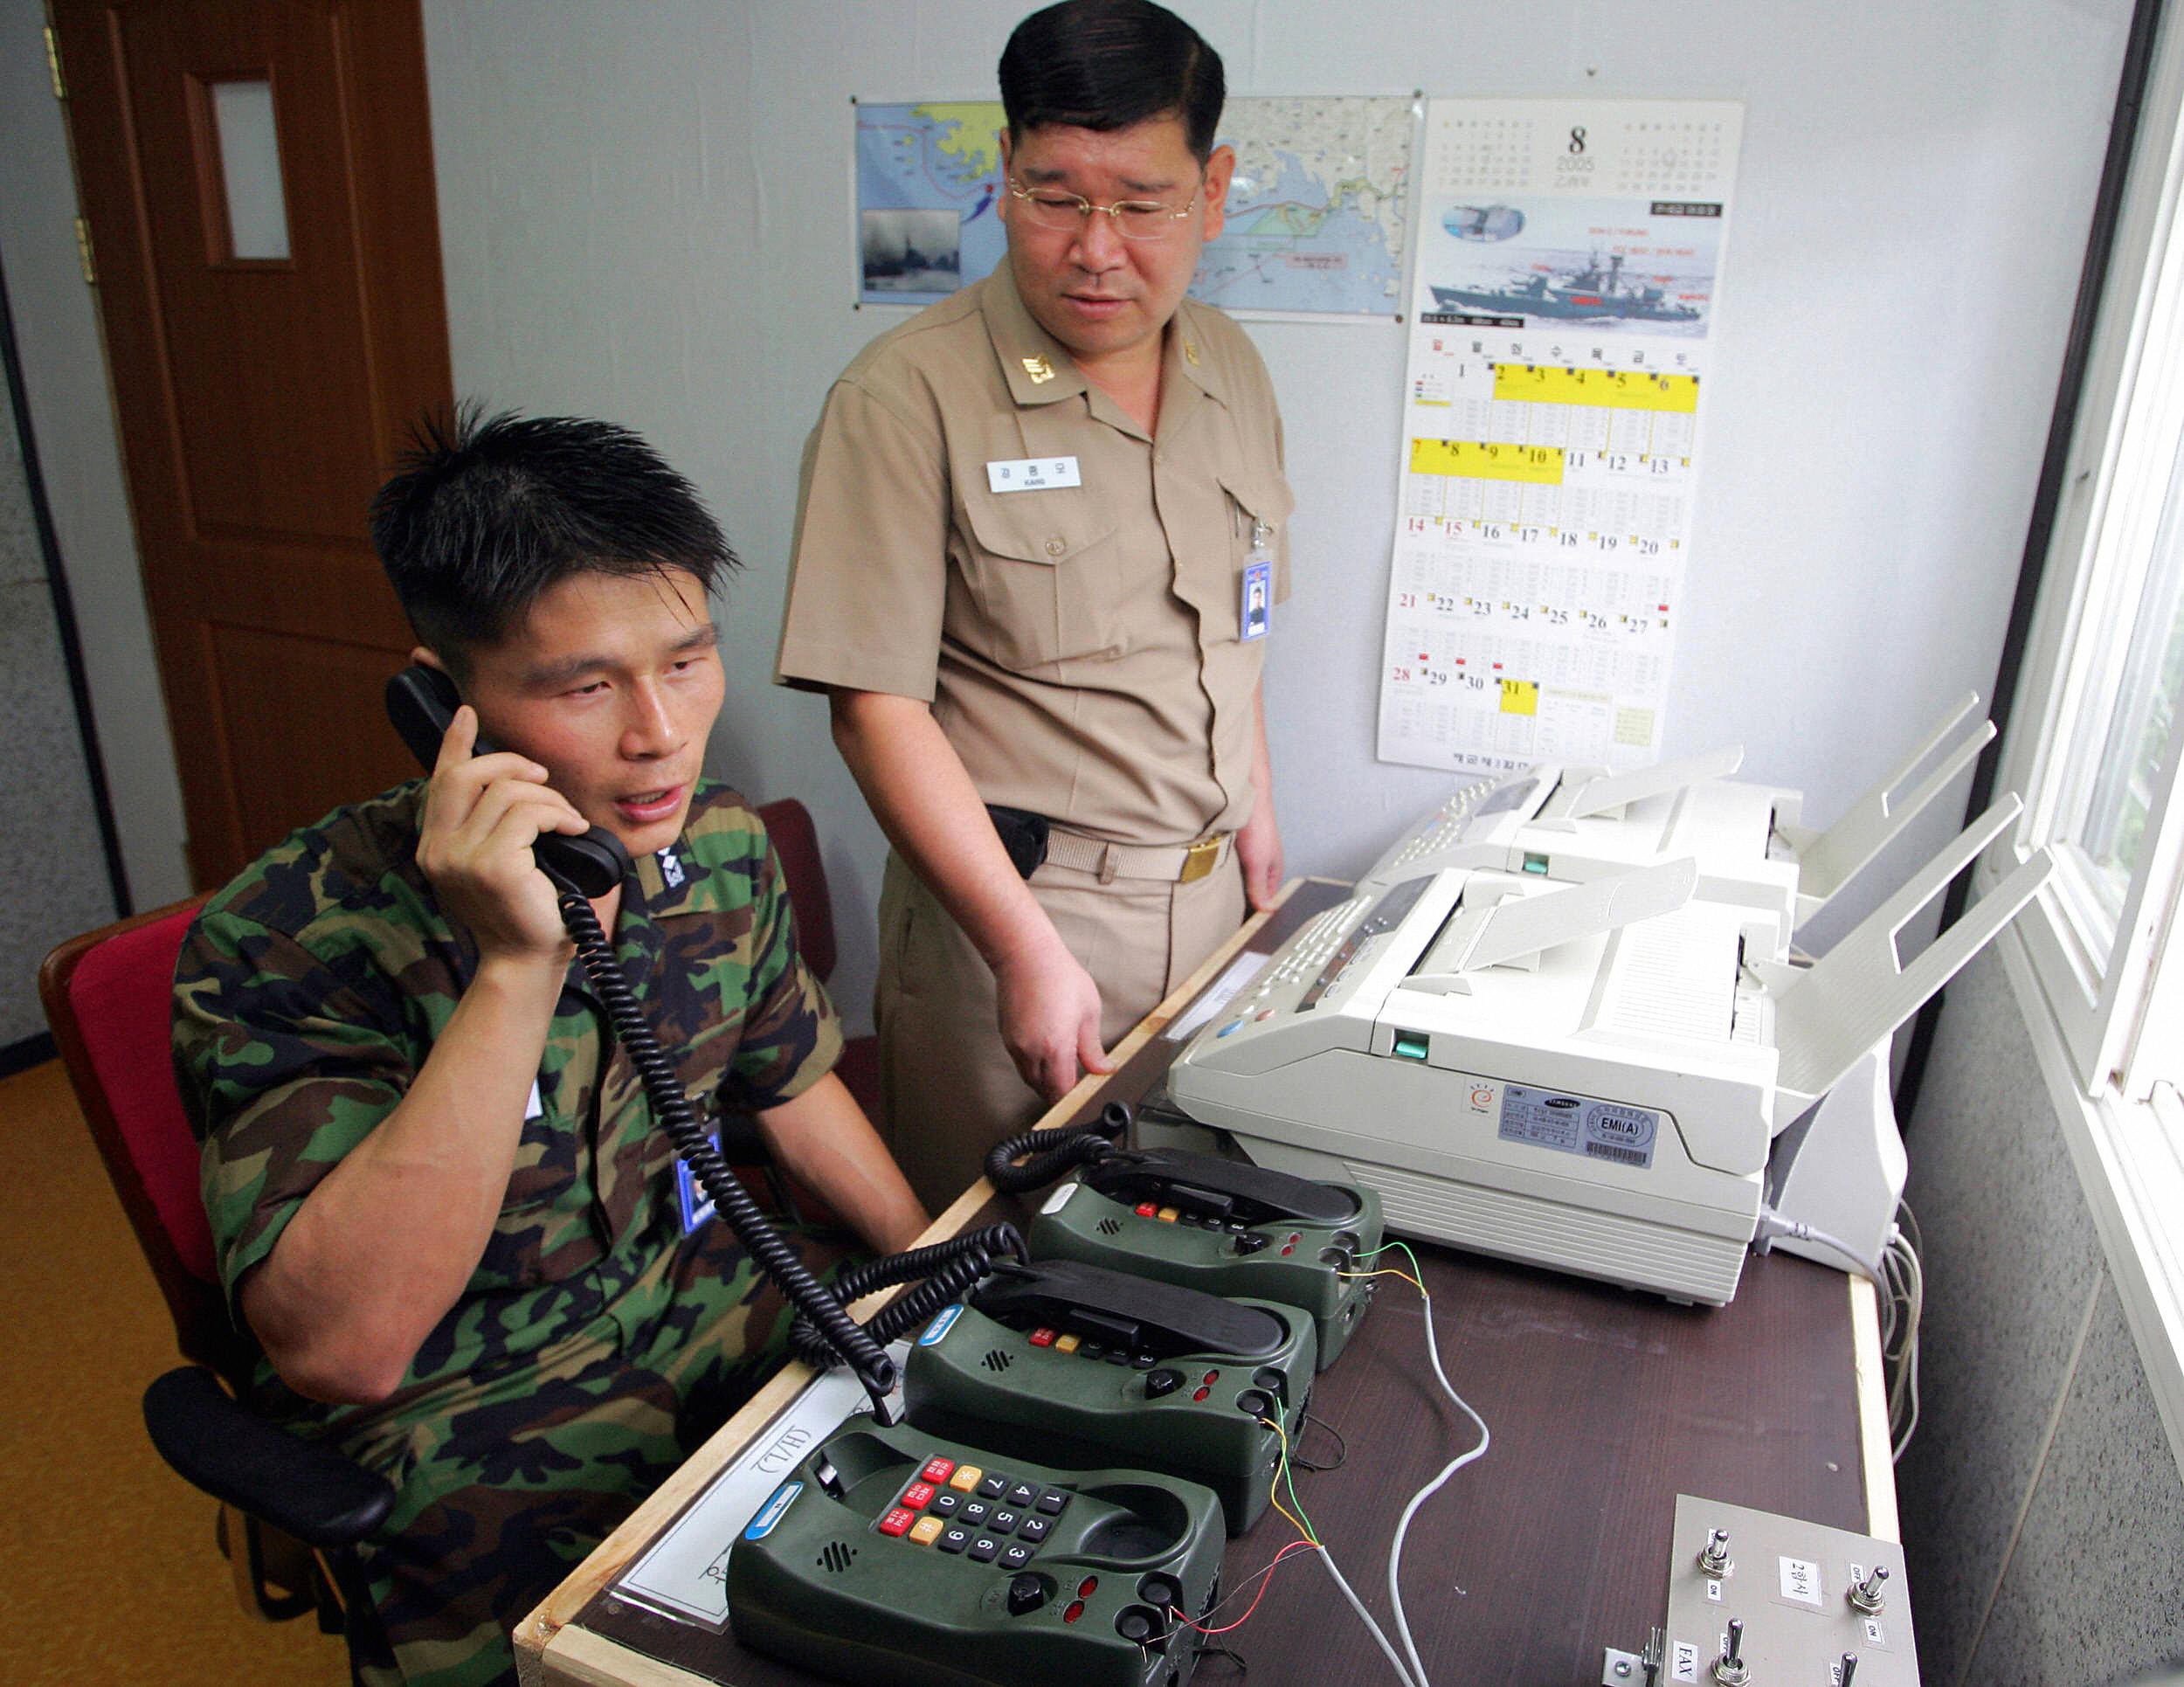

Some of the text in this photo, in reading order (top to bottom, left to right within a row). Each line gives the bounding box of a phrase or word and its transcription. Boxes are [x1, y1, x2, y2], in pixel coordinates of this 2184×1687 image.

[1570, 126, 1586, 155] 8
[1460, 364, 1669, 391] 1 2 3 4 5 6
[1413, 439, 1668, 474] 7 8 9 10 11 12 13
[1409, 517, 1658, 554] 14 15 16 17 18 19 20
[1400, 593, 1648, 633] 21 22 23 24 25 26 27
[1394, 667, 1518, 695] 28 29 30 31
[1601, 1117, 1639, 1135] EMI(A)
[988, 1479, 1004, 1489] 7
[1015, 1486, 1030, 1496] 4
[939, 1496, 955, 1506] 0
[968, 1504, 984, 1513] 8
[998, 1512, 1013, 1523] 5
[1026, 1520, 1042, 1530] 2
[949, 1530, 964, 1540] 9
[978, 1539, 993, 1550] 6
[1009, 1547, 1025, 1558] 3
[1711, 1585, 1717, 1595] ON
[1868, 1625, 1876, 1636] ON
[1679, 1646, 1692, 1677] FAX
